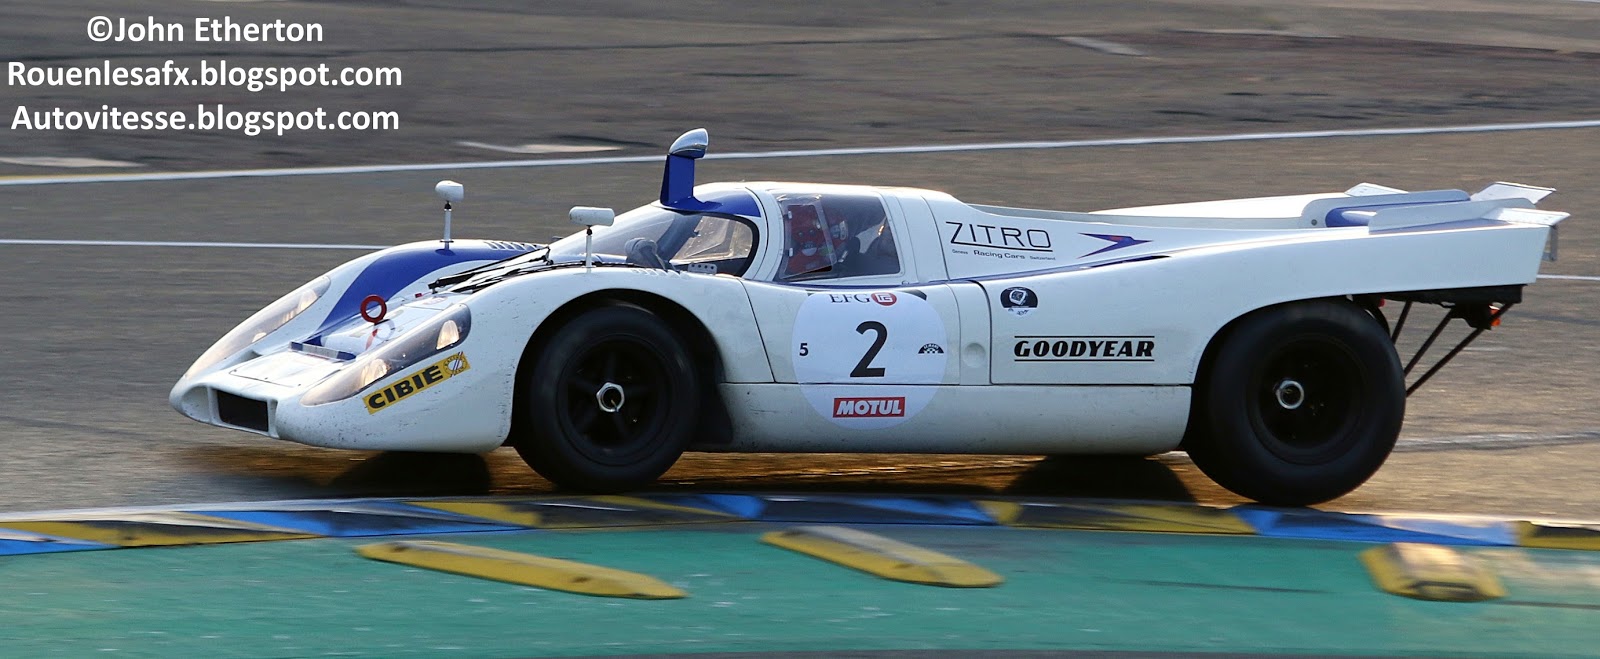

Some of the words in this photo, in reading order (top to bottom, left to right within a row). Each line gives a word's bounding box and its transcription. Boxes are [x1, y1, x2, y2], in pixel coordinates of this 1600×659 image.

[946, 221, 1052, 249] ZITRO
[973, 249, 1003, 259] Racing
[1004, 252, 1026, 260] Cars
[829, 293, 871, 304] EFG
[798, 342, 809, 357] 5
[849, 320, 888, 378] 2
[1014, 340, 1155, 358] GOODYEAR
[836, 399, 902, 415] MOTUL
